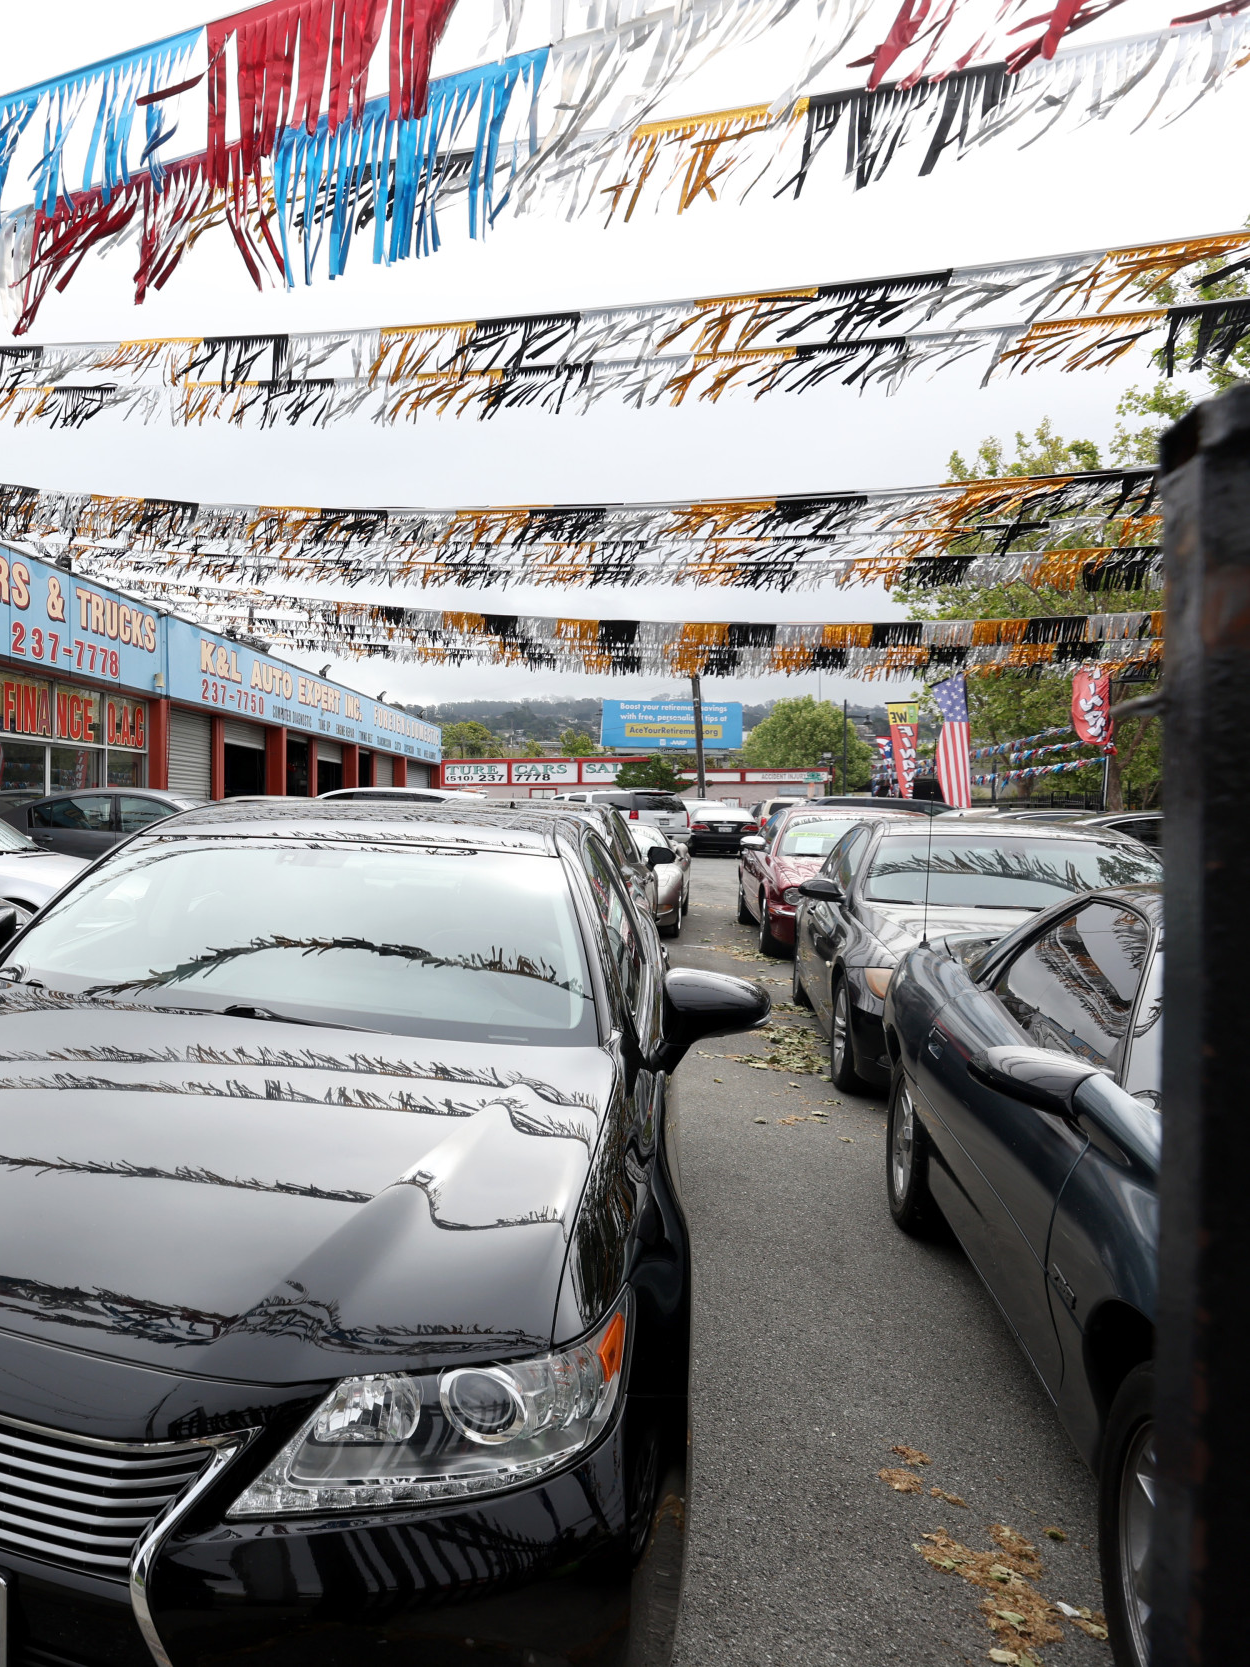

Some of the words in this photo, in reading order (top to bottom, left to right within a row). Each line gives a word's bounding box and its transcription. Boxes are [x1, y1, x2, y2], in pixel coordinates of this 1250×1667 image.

[46, 575, 66, 623] &
[75, 586, 156, 653] TRUCKS
[11, 621, 120, 679] 237-7778
[200, 638, 242, 685] K&L
[250, 660, 293, 700] AUTO
[297, 676, 341, 716] EXPERT
[344, 692, 363, 722] INC.
[374, 705, 405, 736] FOREIGN
[201, 678, 265, 716] 237-7750
[3, 681, 95, 743] FINANCE
[620, 702, 641, 710] Boost
[642, 704, 659, 712] your
[661, 703, 695, 711] retireme
[657, 714, 703, 722] personaliz
[705, 715, 718, 723] tips
[629, 726, 719, 737] AceYourRetireme.org
[446, 764, 499, 775] TURE
[514, 764, 567, 775] CARS
[586, 763, 620, 774] SAL
[479, 774, 504, 782] 237
